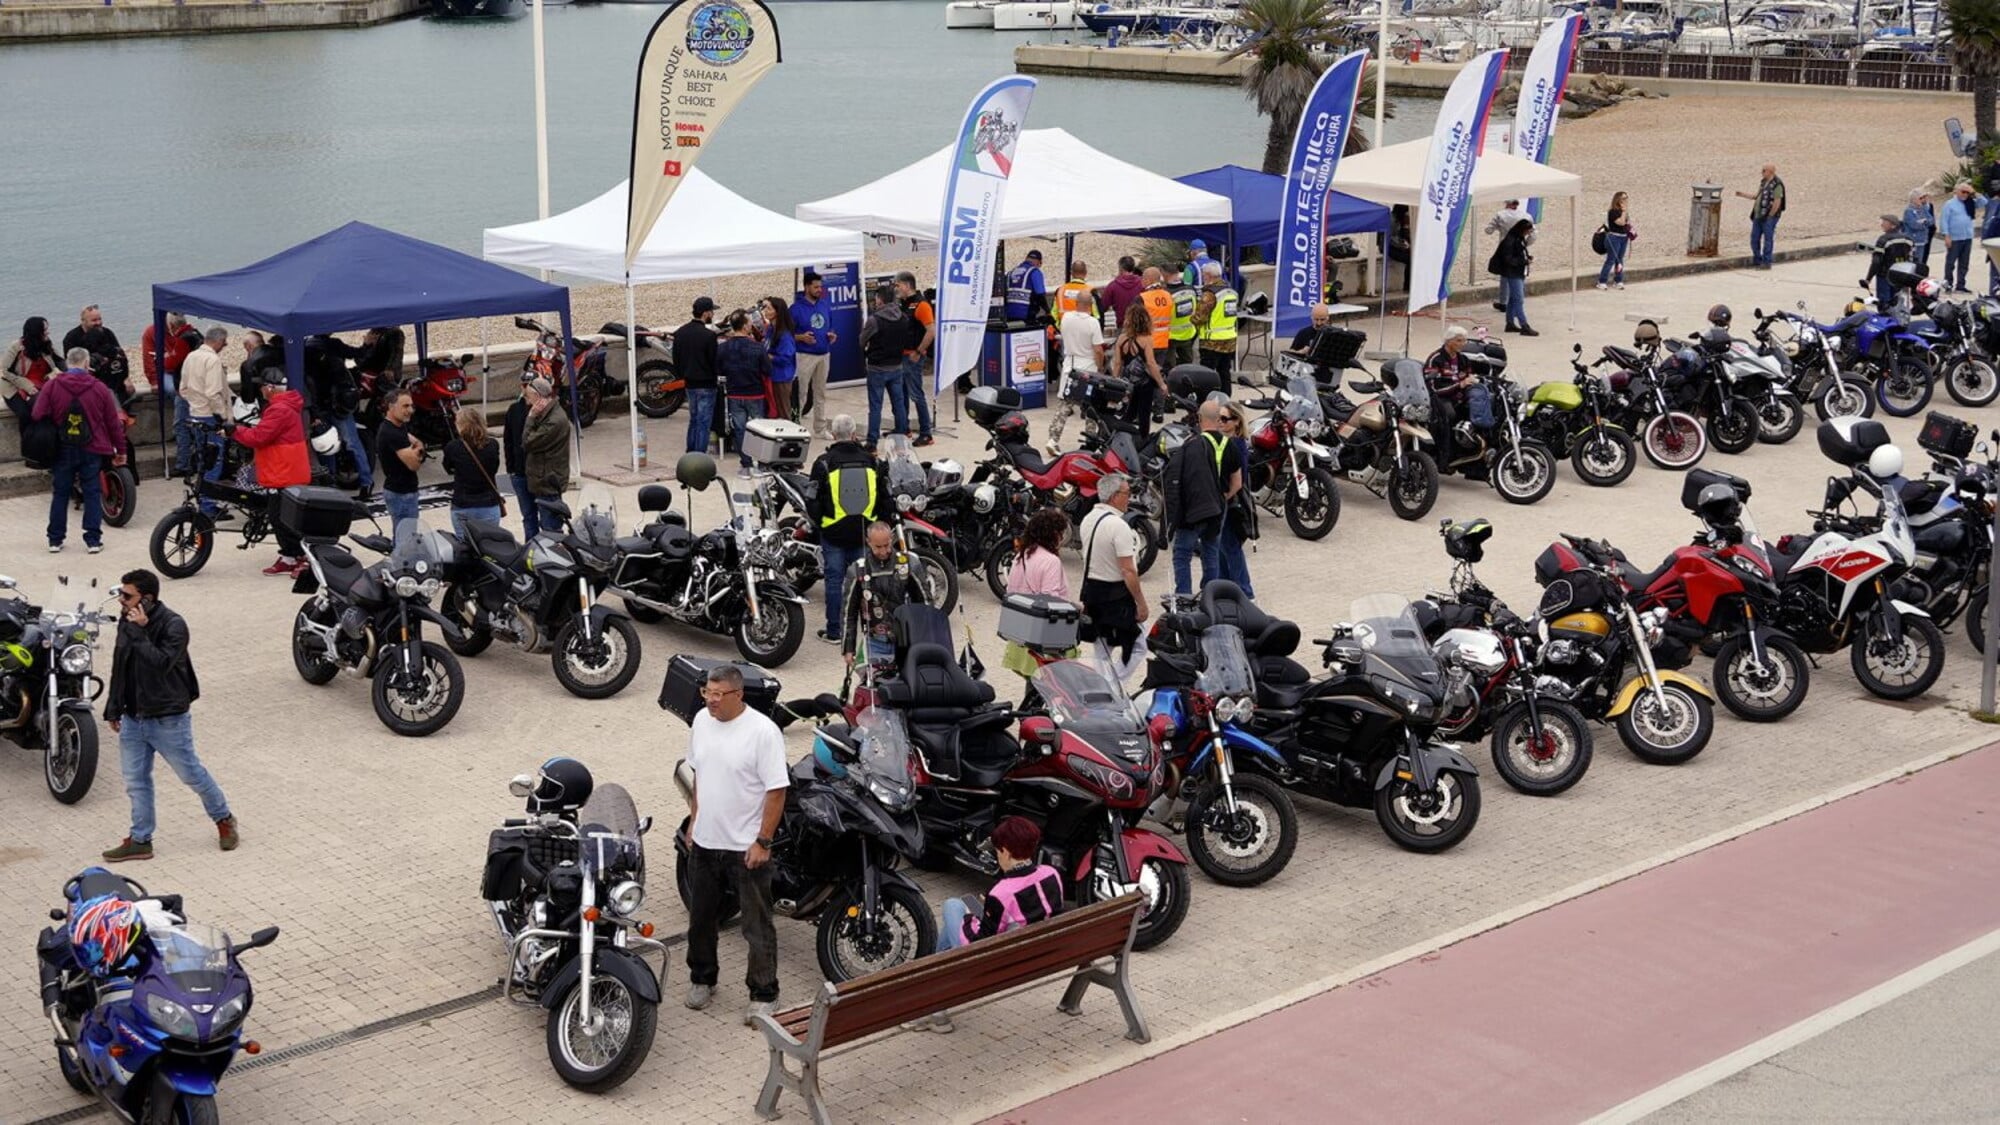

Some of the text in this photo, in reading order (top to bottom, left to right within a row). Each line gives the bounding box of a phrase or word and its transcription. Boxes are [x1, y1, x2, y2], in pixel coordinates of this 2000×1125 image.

[690, 39, 748, 49] MOTOVUNQUE
[660, 45, 685, 150] MOTOVUNQUE
[677, 95, 716, 108] CHOICE
[683, 68, 728, 82] SAHARA
[687, 81, 713, 93] BEST
[1533, 77, 1546, 114] club
[1434, 121, 1464, 221] moto club
[1308, 114, 1342, 308] DI FORMAZIONE ALLA GUIDA SICURA
[948, 205, 979, 285] PSM
[970, 261, 980, 305] PASSIONE
[975, 228, 985, 260] SICURA
[981, 191, 992, 216] MOTO
[1290, 232, 1309, 307] POLO
[827, 284, 858, 304] TIM
